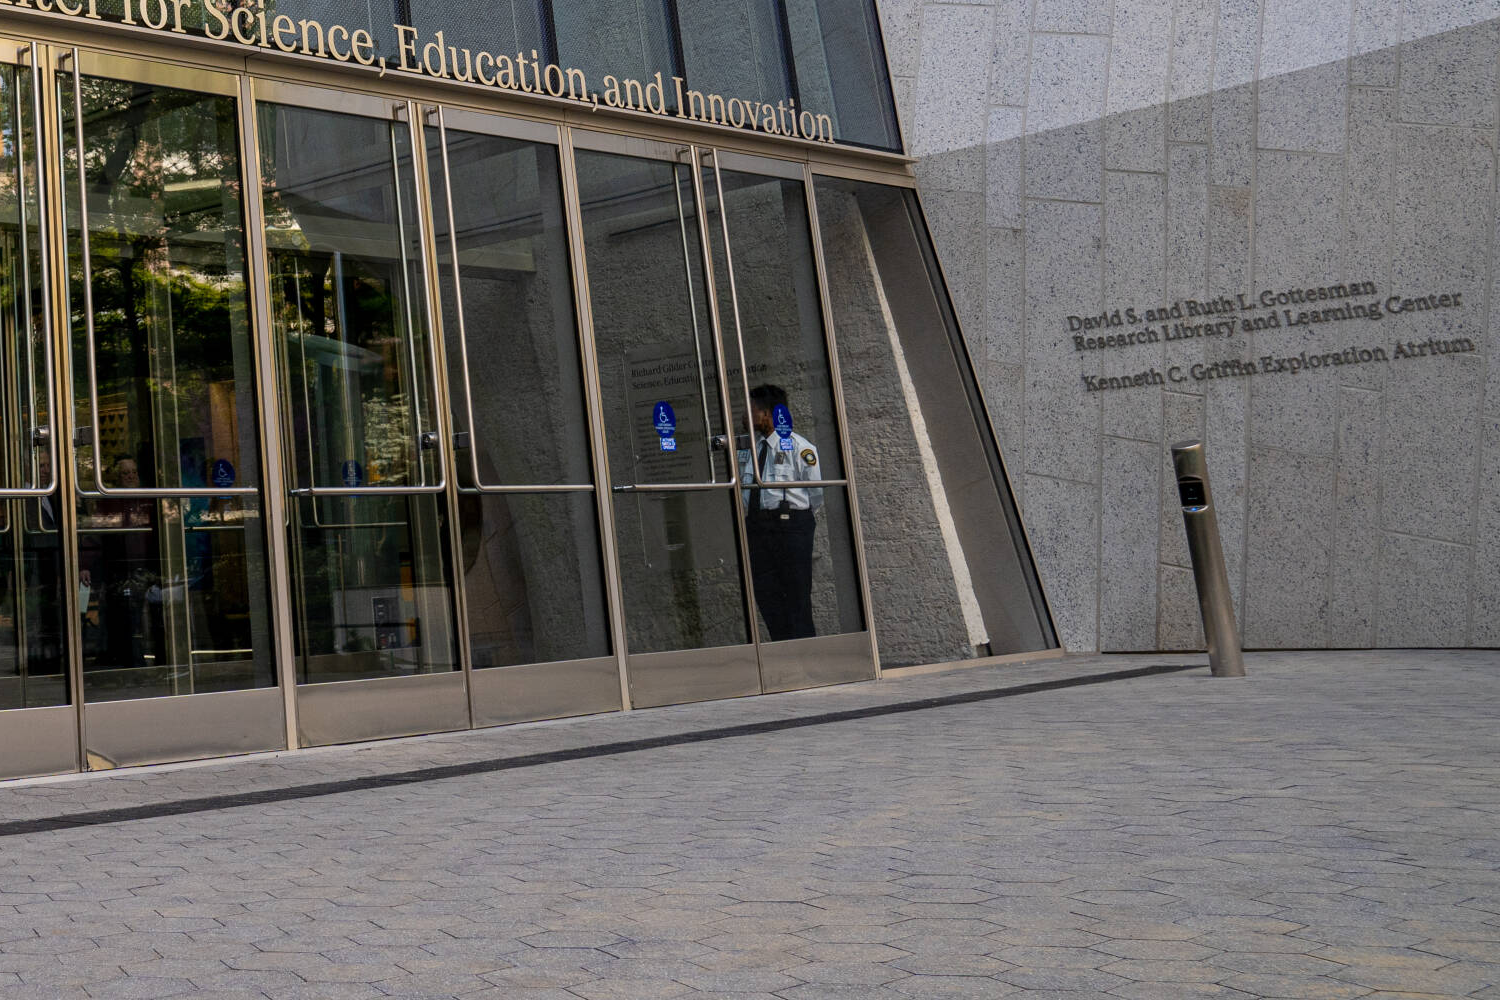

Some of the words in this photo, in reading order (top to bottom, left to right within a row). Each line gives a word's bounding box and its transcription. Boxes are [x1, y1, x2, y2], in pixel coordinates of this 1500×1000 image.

[394, 23, 599, 113] Education,
[604, 71, 668, 118] and
[671, 75, 836, 145] Innovation
[1067, 309, 1124, 332] David
[1125, 308, 1143, 325] S.
[1146, 302, 1183, 322] and
[1185, 296, 1235, 317] Ruth
[1237, 294, 1256, 311] L.
[1260, 281, 1377, 308] Gottesman
[1073, 327, 1160, 351] Research
[1161, 319, 1236, 342] Library
[1241, 310, 1281, 332] and
[1283, 301, 1384, 327] Learning
[1385, 292, 1463, 315] Center
[1083, 367, 1165, 392] Kenneth
[1167, 366, 1188, 384] C.
[1190, 358, 1258, 381] Griffin
[1260, 346, 1389, 374] Exploration
[1393, 337, 1475, 360] Atrium
